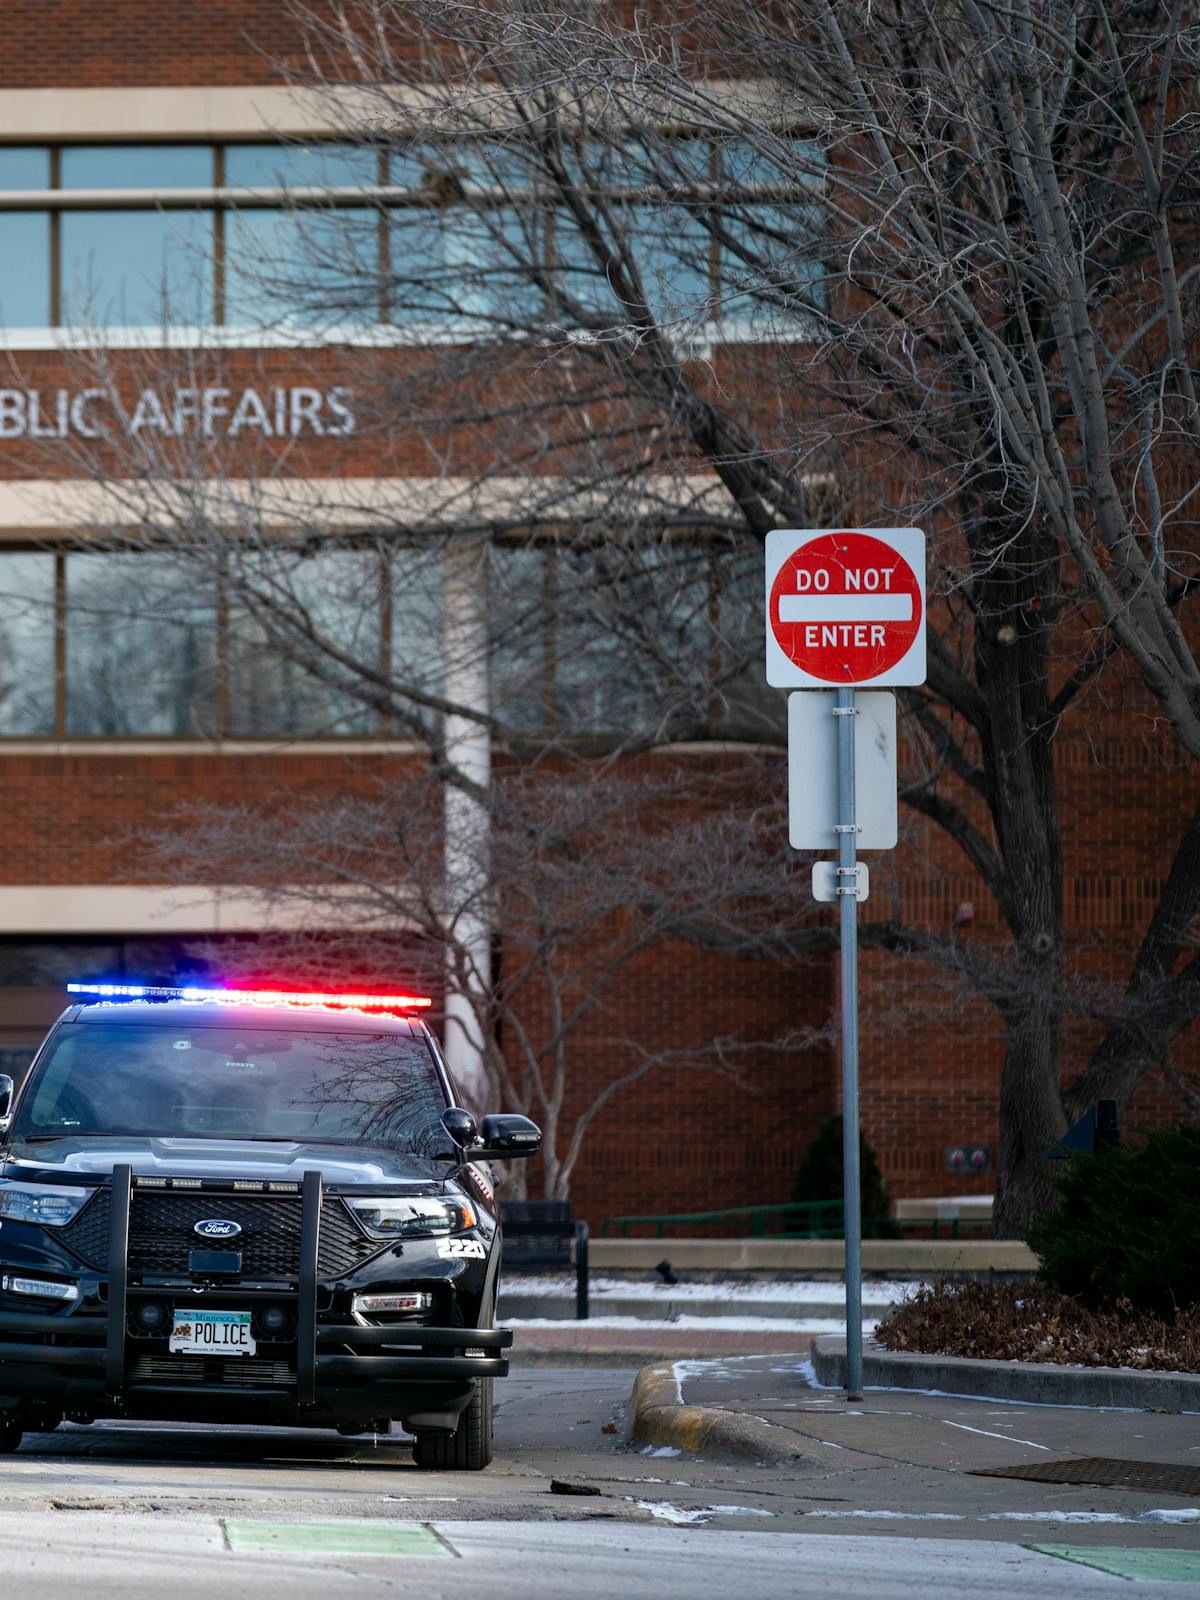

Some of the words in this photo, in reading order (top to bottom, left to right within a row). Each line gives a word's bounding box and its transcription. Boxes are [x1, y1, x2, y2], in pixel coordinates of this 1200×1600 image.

[130, 387, 356, 437] AFFAIRS
[796, 568, 830, 591] DO
[845, 568, 894, 591] NOT
[805, 625, 886, 647] ENTER
[204, 1222, 231, 1233] Ford
[435, 1238, 486, 1259] 2220
[195, 1322, 248, 1345] POLICE
